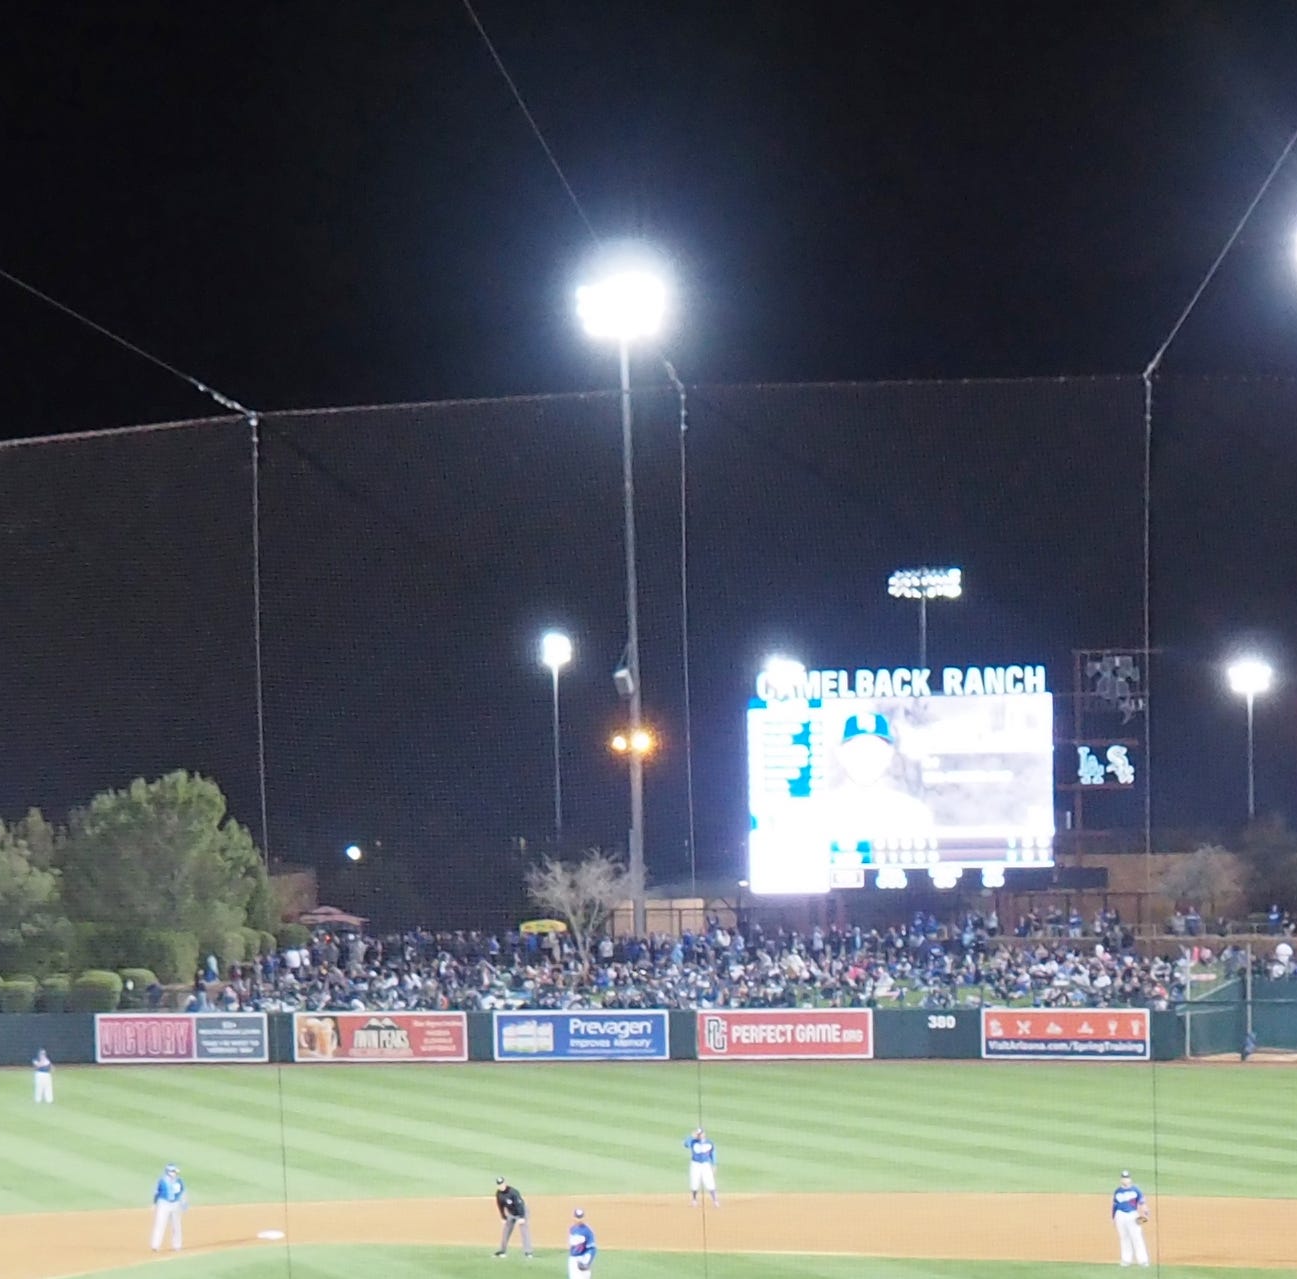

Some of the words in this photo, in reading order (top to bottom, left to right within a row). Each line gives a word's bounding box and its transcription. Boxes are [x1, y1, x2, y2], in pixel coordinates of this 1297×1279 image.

[943, 665, 1046, 696] RANCH
[569, 1018, 652, 1039] Prevagen
[927, 1015, 956, 1029] 380
[100, 1020, 189, 1055] VICTORY
[379, 1029, 410, 1048] PEAKS
[731, 1024, 793, 1043] PERFECT
